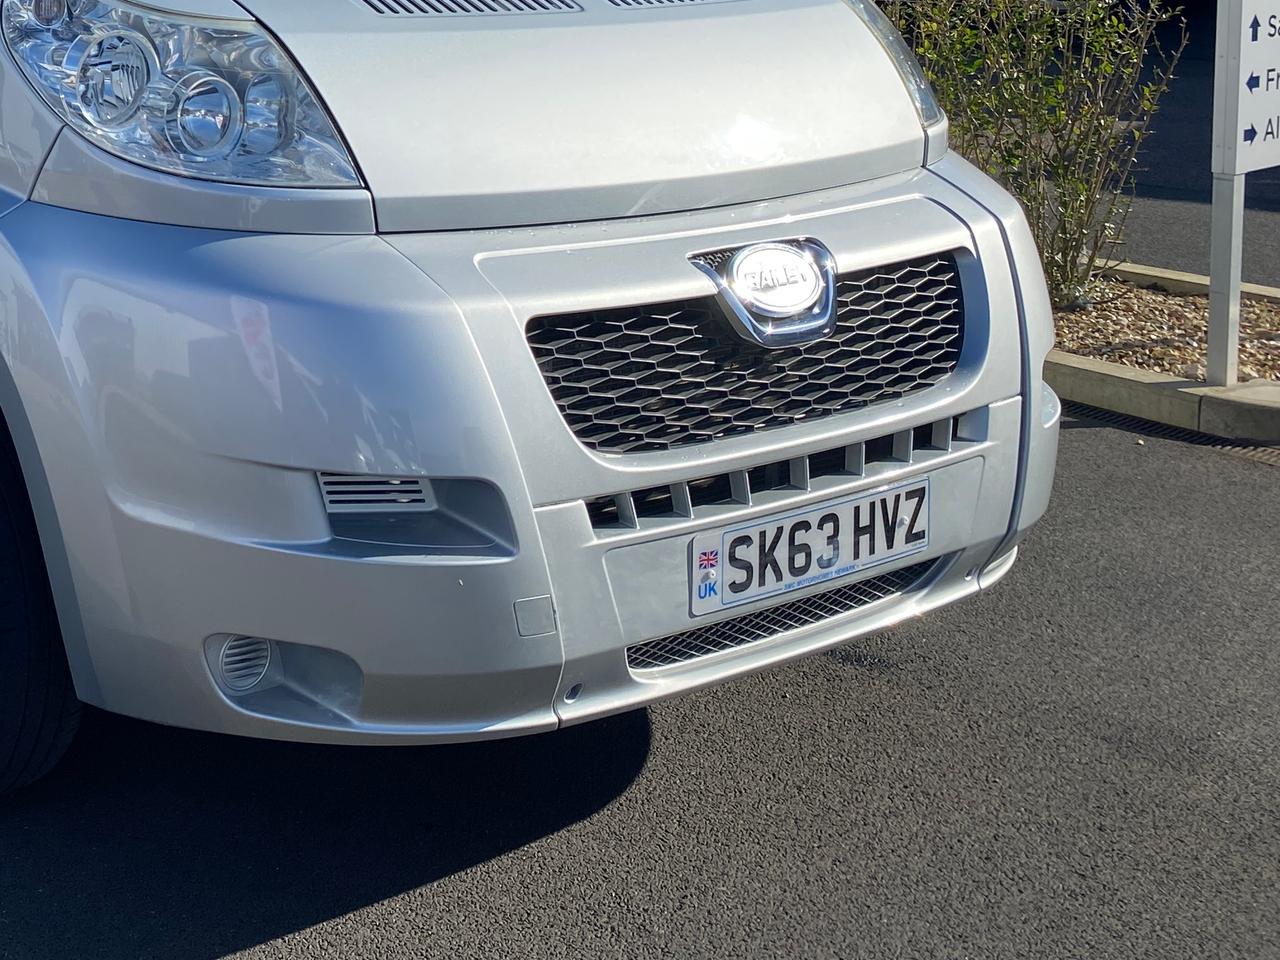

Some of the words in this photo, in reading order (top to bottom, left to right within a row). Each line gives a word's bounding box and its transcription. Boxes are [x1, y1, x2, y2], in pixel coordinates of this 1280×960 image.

[728, 512, 840, 594] SK63
[853, 486, 926, 561] HVZ
[698, 580, 718, 599] UK
